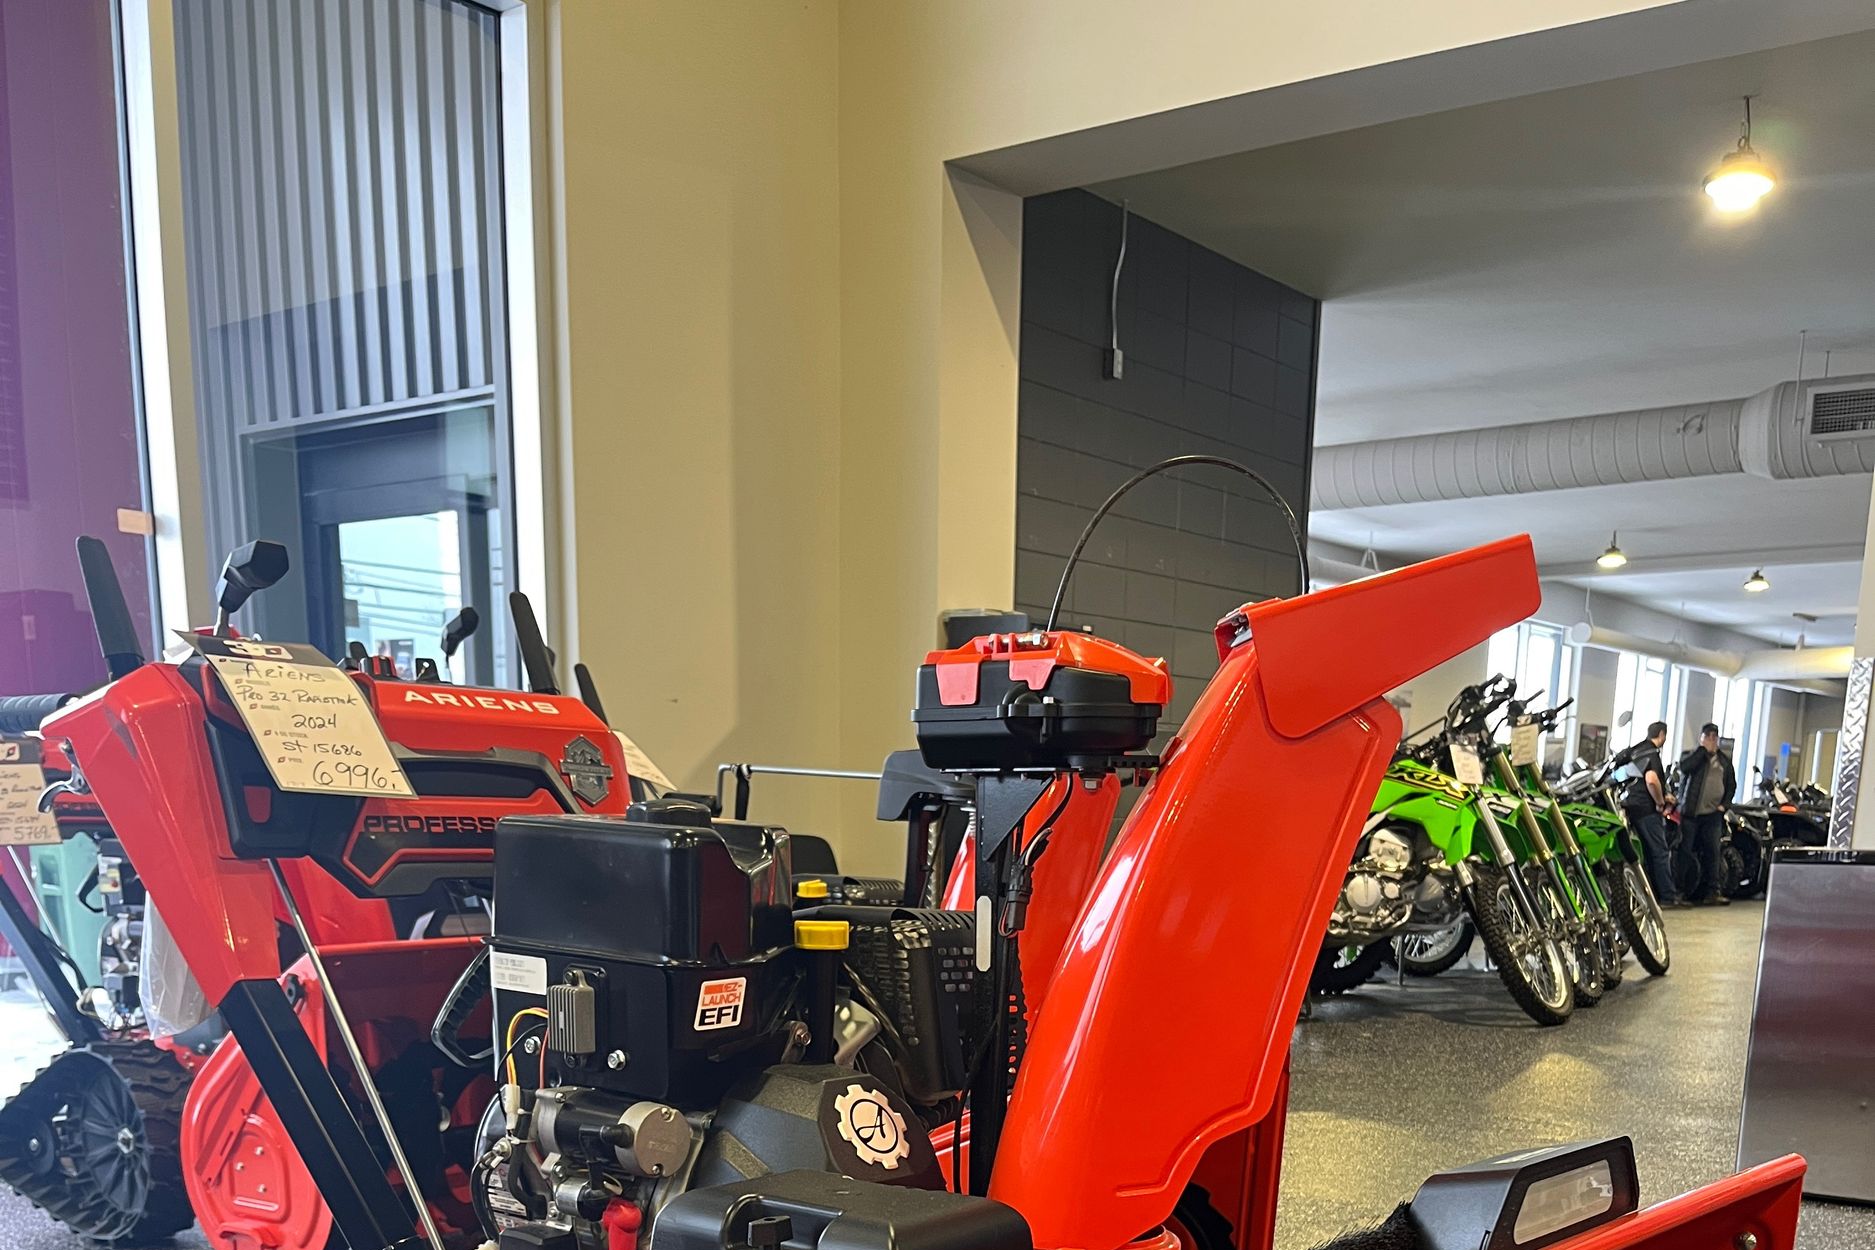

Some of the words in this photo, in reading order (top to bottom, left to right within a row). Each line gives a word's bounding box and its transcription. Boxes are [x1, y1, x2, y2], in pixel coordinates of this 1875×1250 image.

[268, 691, 291, 702] 32
[405, 690, 560, 715] ARIENS
[291, 714, 337, 729] 2024
[313, 743, 362, 756] 15686
[363, 815, 502, 833] PROFESS
[702, 992, 741, 1007] LAUNCH
[698, 1005, 739, 1026] EFI
